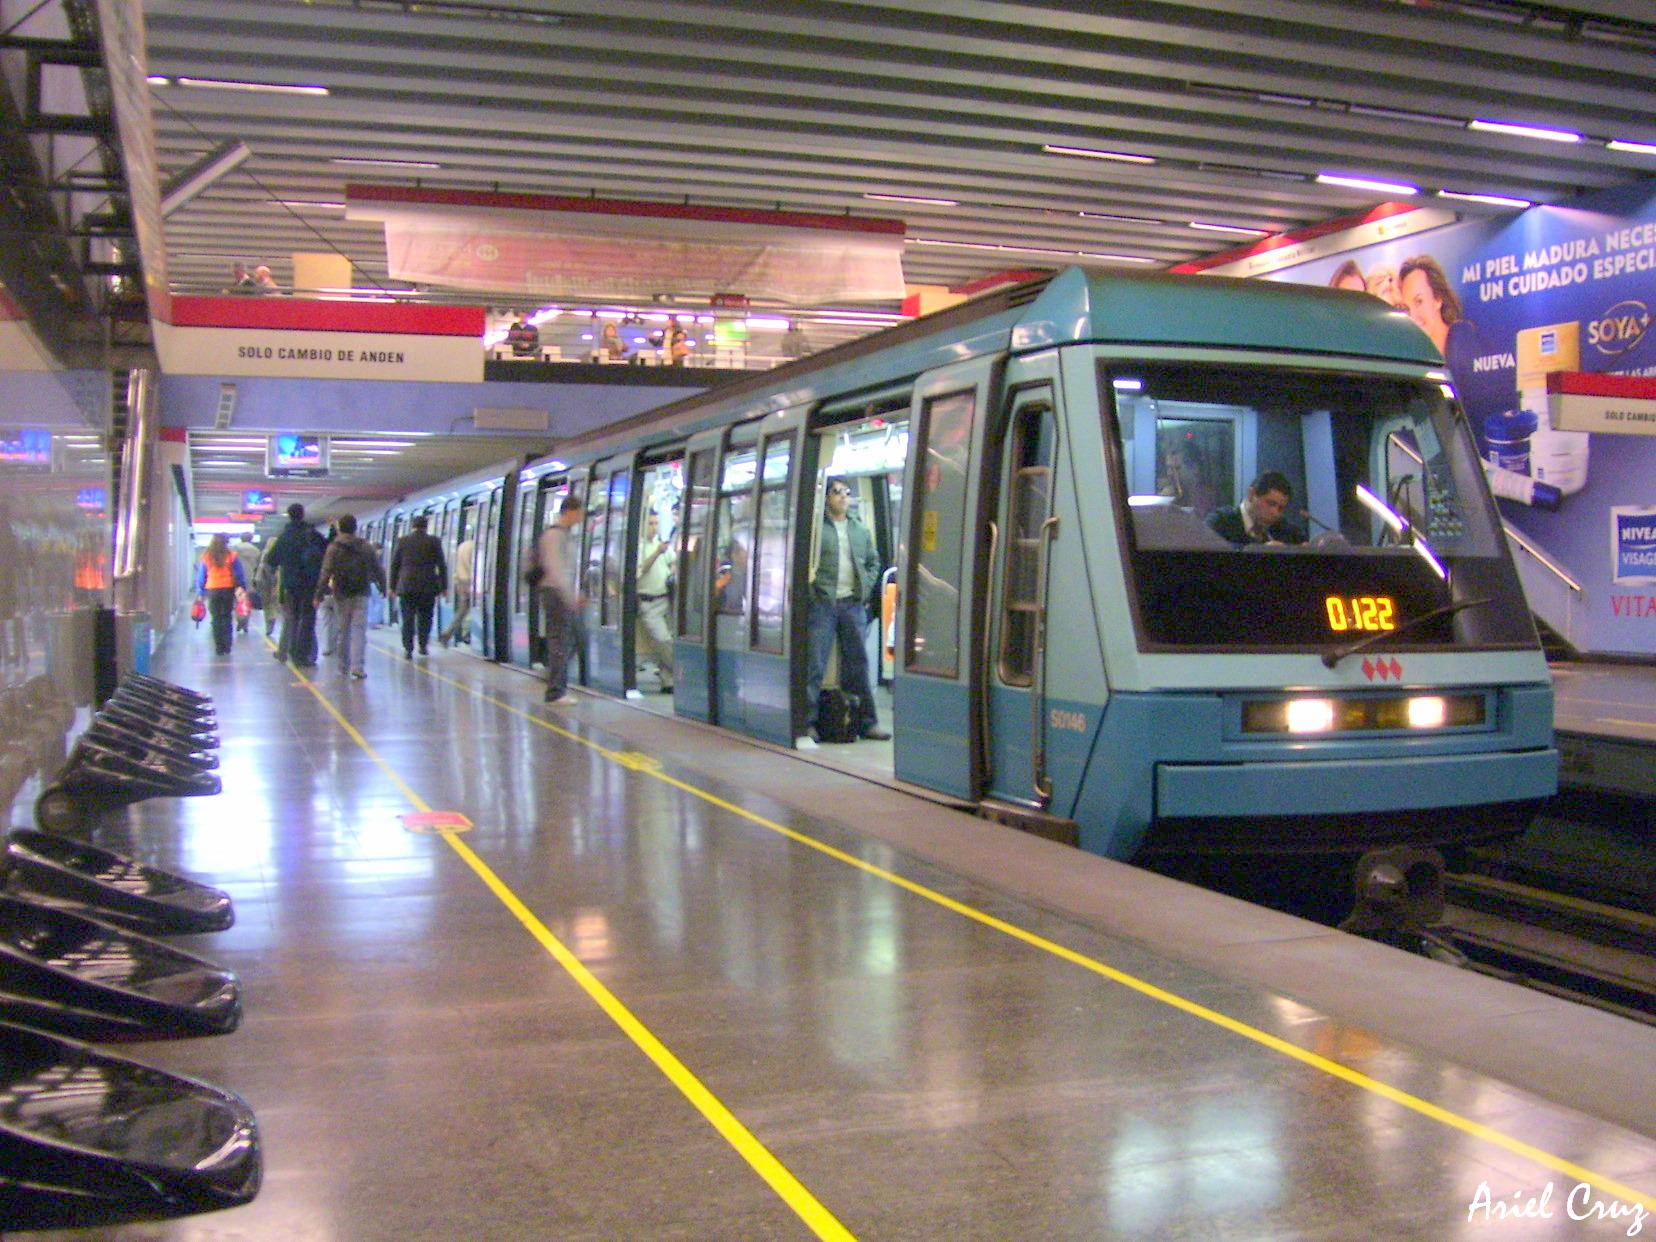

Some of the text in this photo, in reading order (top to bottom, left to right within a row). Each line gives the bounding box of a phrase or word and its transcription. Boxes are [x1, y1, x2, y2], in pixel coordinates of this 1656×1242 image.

[1462, 223, 1656, 284] MI PIEL MADURA NECE
[1479, 248, 1656, 302] UN CUIDADO ESPECI
[238, 346, 405, 364] SOLO CAMBIO DE ANDEN
[1473, 353, 1517, 373] NUEVA
